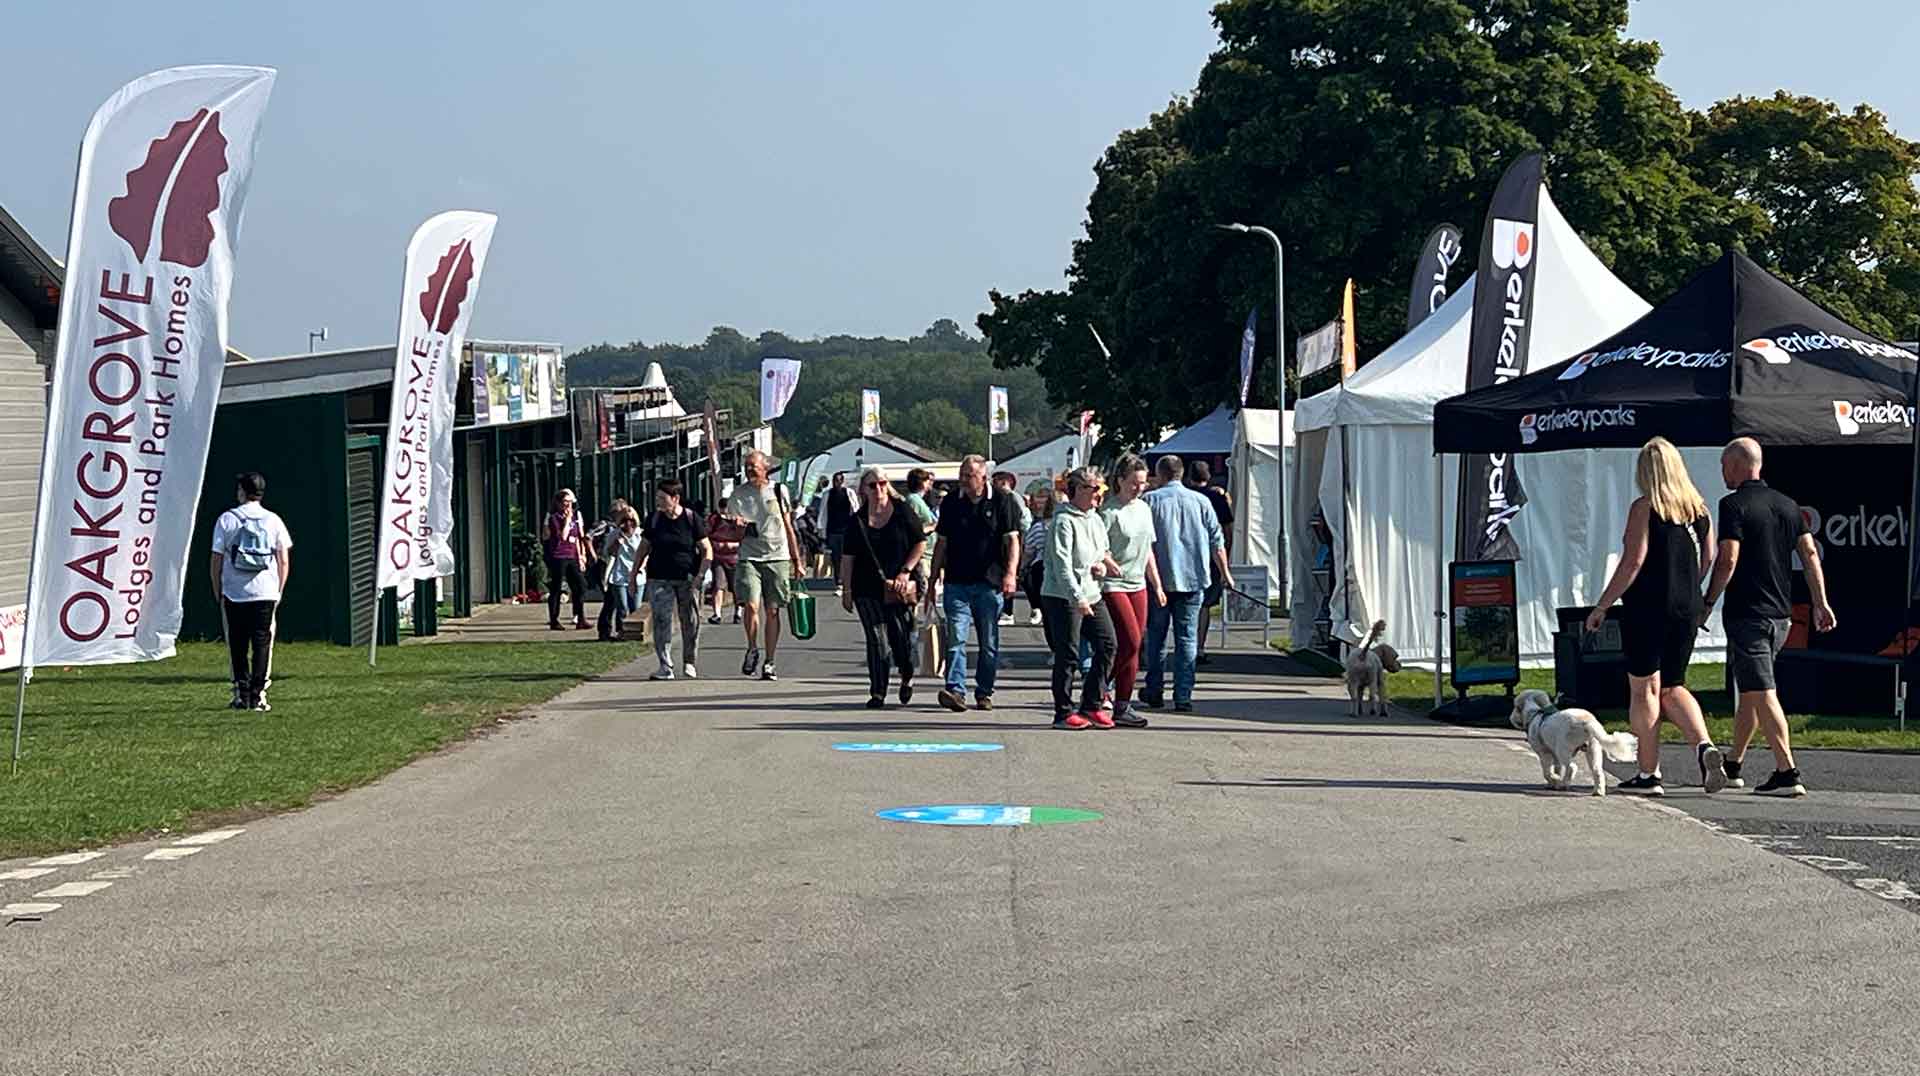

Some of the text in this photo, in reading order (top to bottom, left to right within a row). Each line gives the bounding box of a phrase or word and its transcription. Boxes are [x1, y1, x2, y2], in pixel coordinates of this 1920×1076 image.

[59, 269, 154, 643] OAKGROVE
[114, 274, 191, 640] Lodges and Park Homes
[391, 336, 431, 570] OAKGROVE
[413, 339, 443, 568] Lodges and Park Homes
